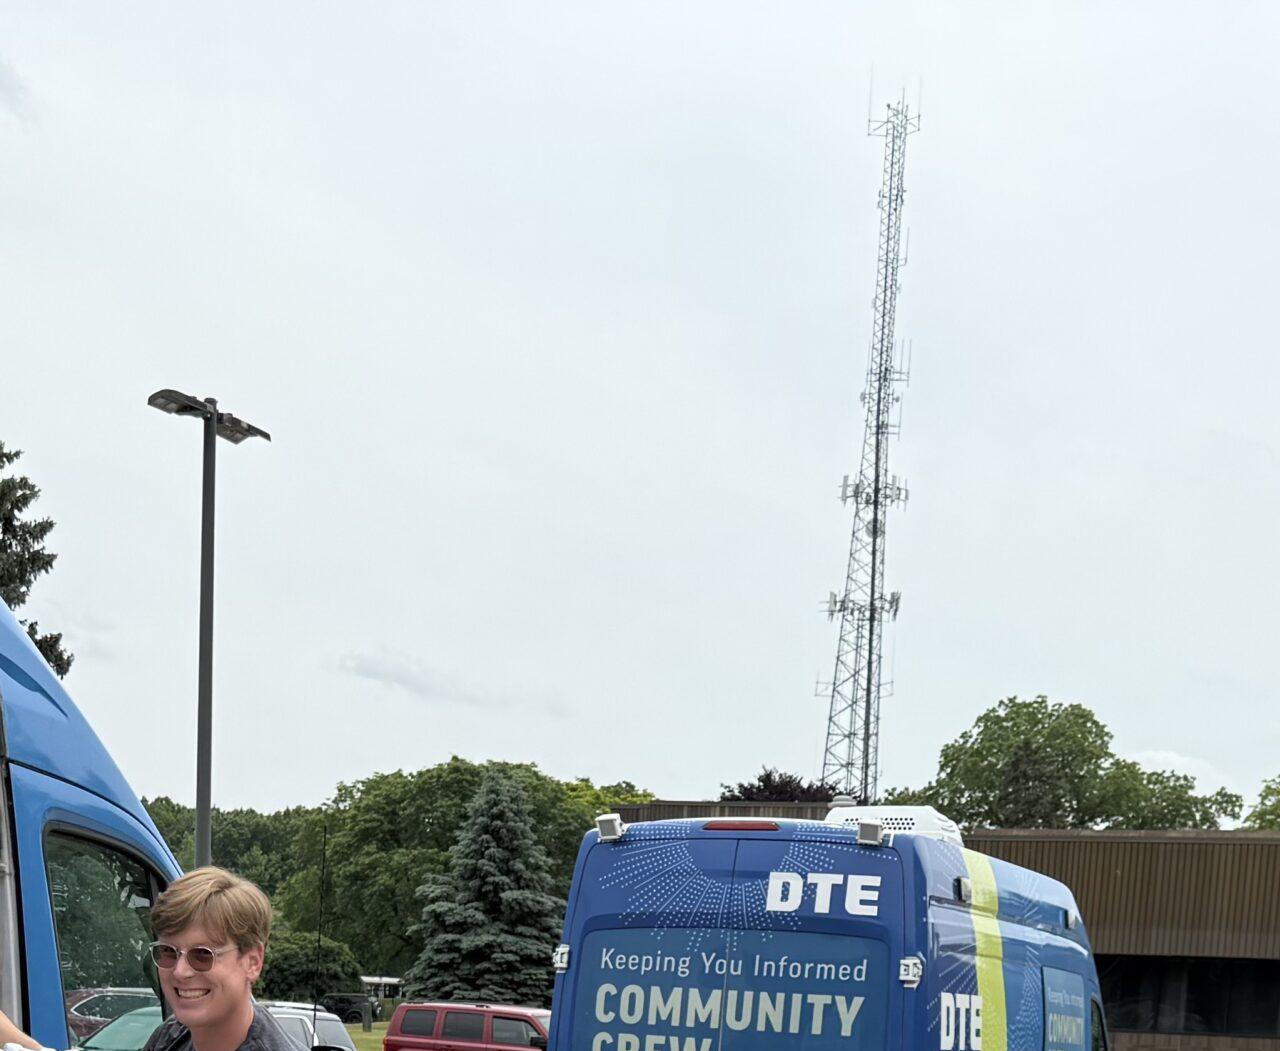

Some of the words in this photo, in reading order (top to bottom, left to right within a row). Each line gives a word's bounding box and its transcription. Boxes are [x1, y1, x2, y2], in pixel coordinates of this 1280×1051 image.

[765, 870, 882, 917] DTE
[600, 948, 691, 977] Keeping
[701, 952, 743, 976] You
[753, 954, 868, 982] Informed
[594, 983, 866, 1037] COMMUNITY
[940, 991, 983, 1051] DTE
